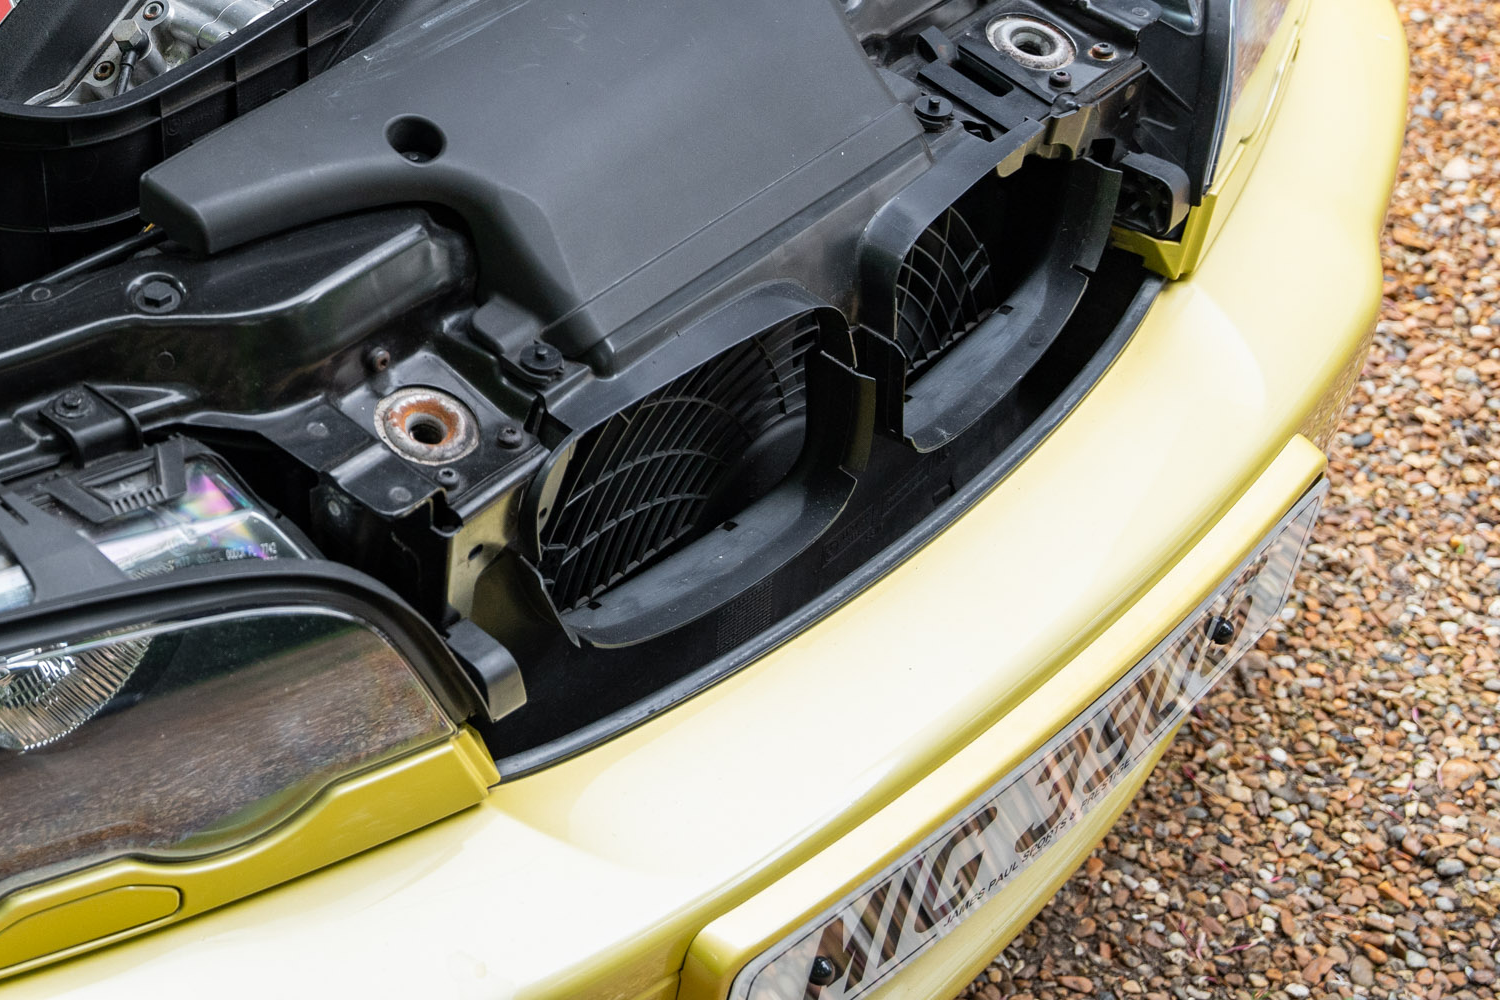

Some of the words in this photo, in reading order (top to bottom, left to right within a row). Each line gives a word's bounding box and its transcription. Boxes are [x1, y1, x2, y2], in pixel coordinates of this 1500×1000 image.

[802, 806, 998, 1000] MIG
[943, 887, 986, 928] JAMES
[987, 861, 1019, 892] PAUL
[1021, 818, 1068, 863] SPORTS
[1080, 758, 1132, 812] PRESTIGE
